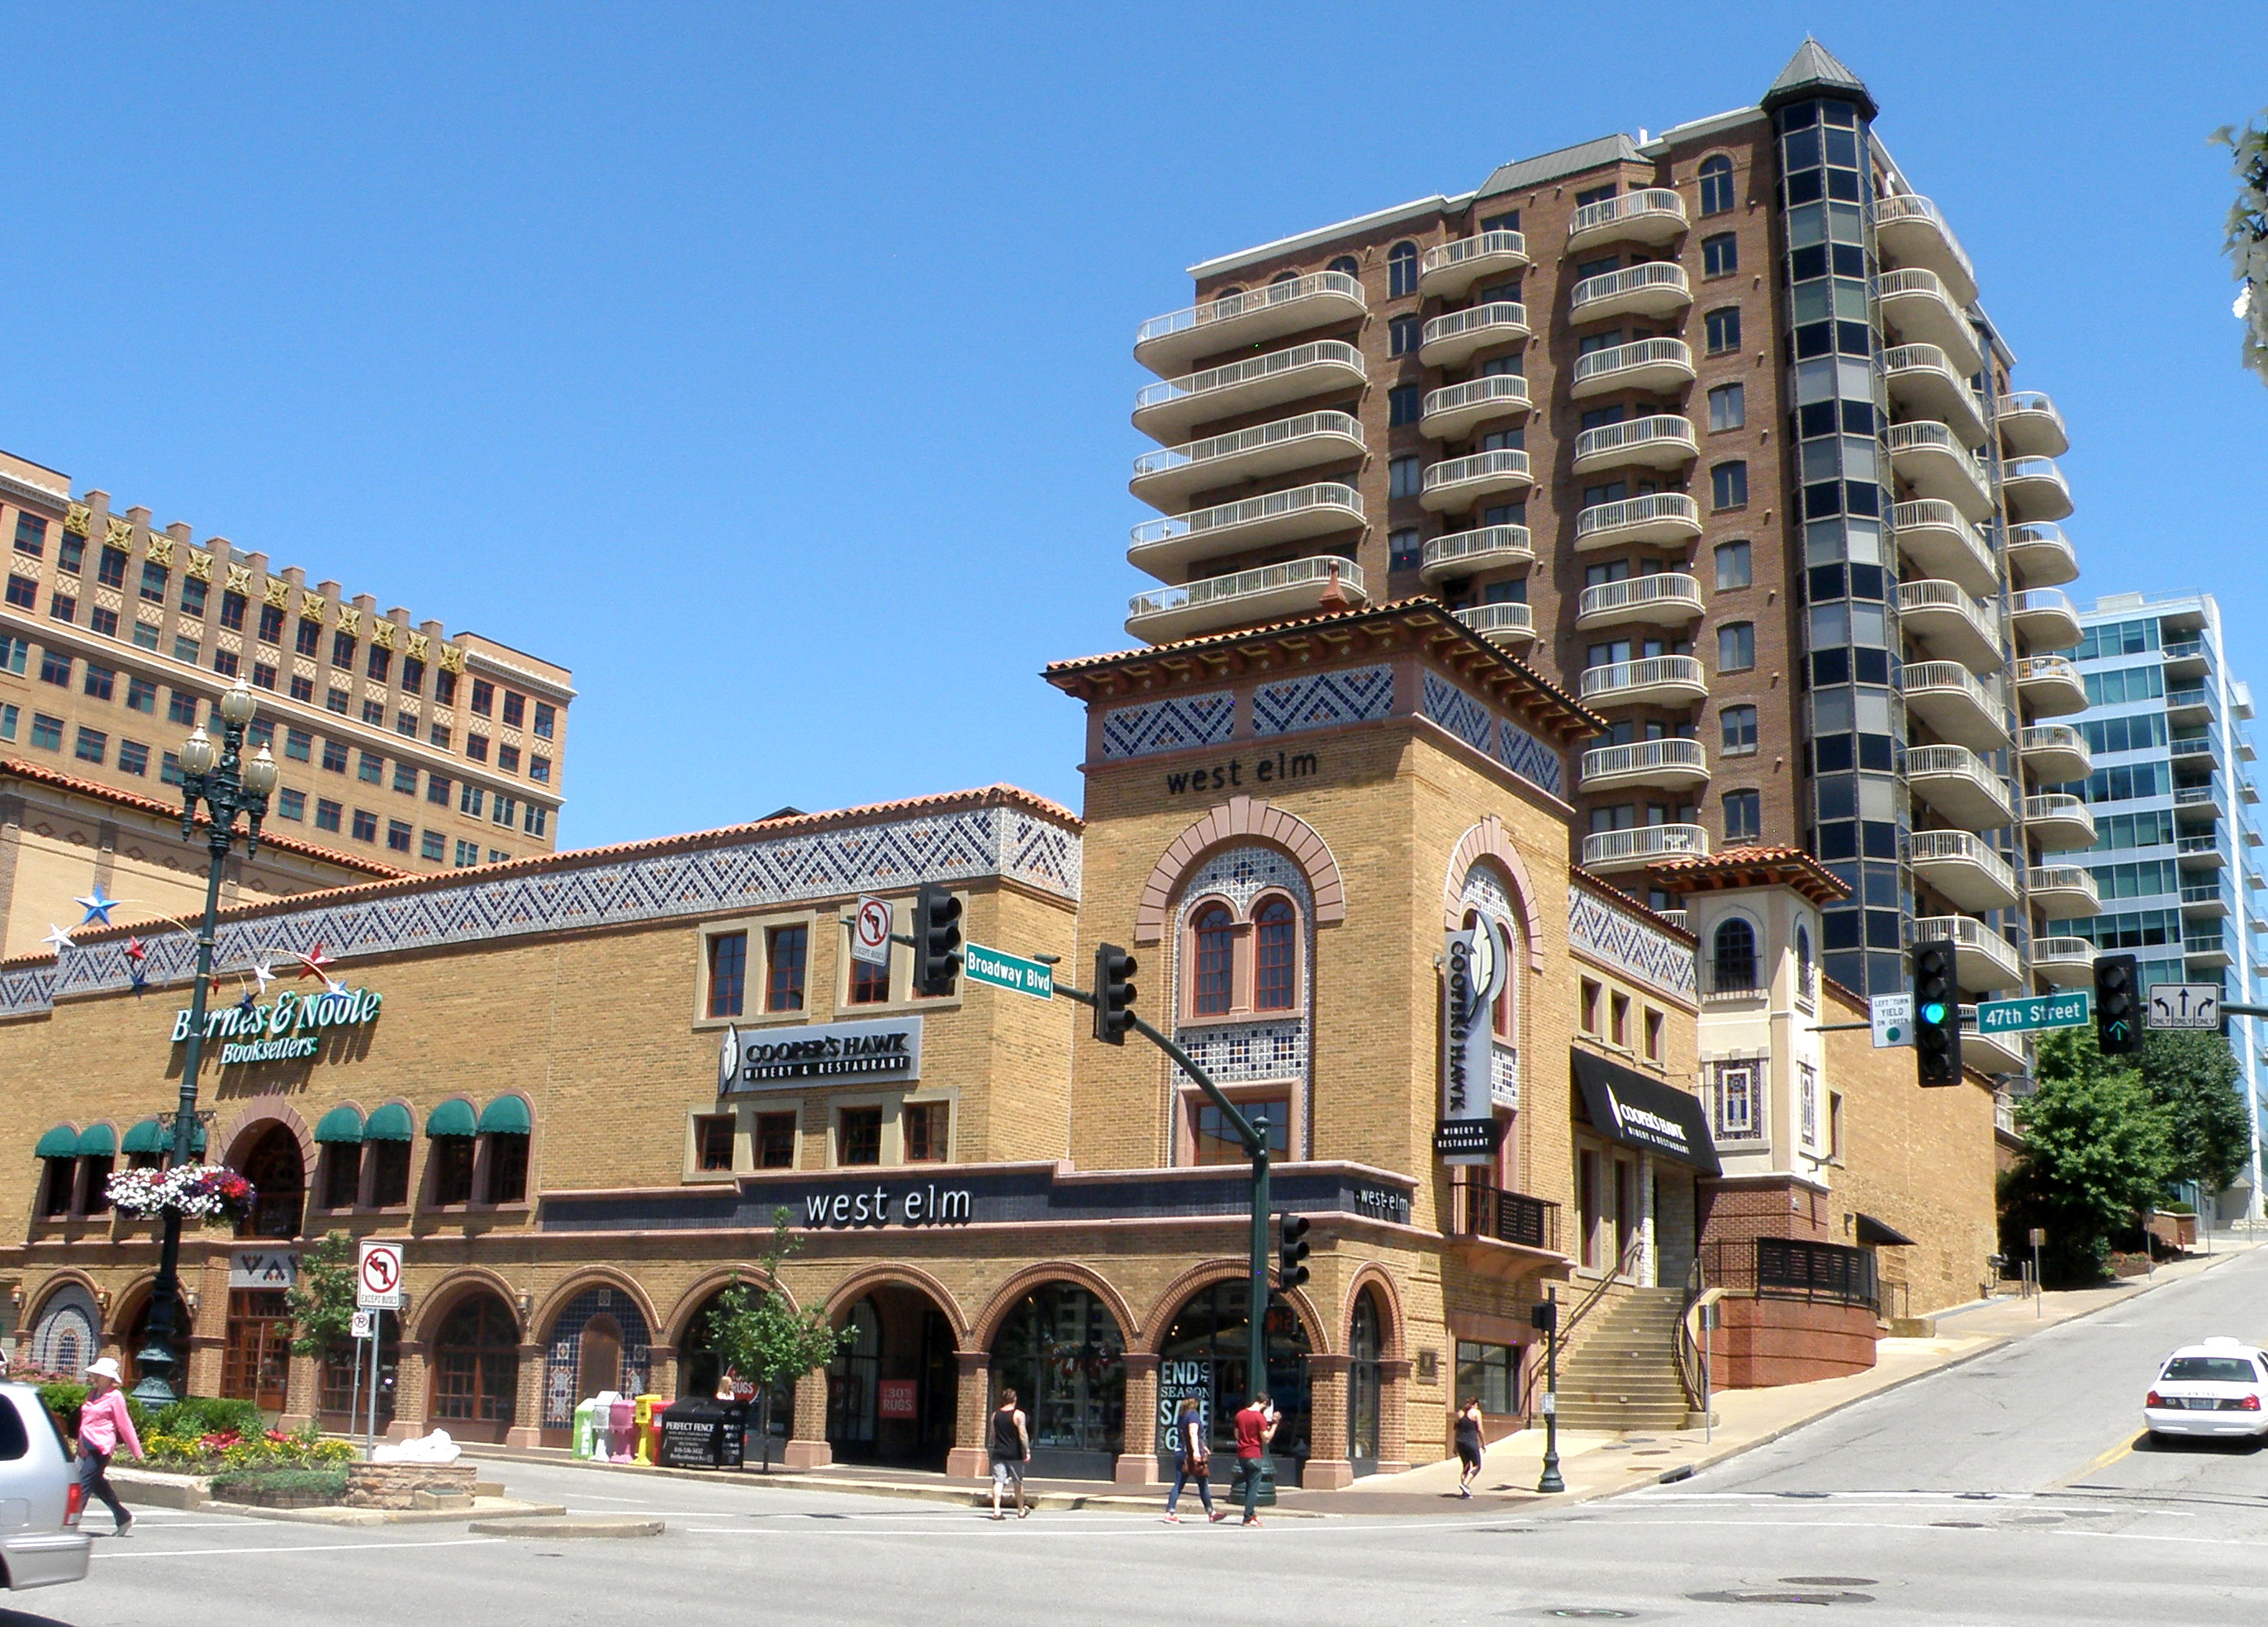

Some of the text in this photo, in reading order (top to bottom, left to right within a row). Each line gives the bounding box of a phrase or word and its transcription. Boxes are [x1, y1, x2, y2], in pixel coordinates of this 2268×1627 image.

[1167, 752, 1317, 795] west elm
[968, 951, 1050, 991] Broadway Blvd
[170, 1005, 270, 1041] Brnes
[269, 990, 300, 1034] &
[1881, 1008, 1903, 1017] YIELD
[1986, 1002, 2081, 1027] 47th Street
[221, 1037, 318, 1064] Booksellers
[746, 1032, 909, 1063] COOPER'S HAWK
[744, 1057, 906, 1080] WINERY & RESTAURANT
[1450, 1044, 1466, 1112] HAWK
[1438, 1137, 1488, 1148] RESTAURANT
[1443, 1126, 1474, 1136] WINERY
[807, 1184, 970, 1221] west elm
[1360, 1189, 1408, 1212] west elm
[1161, 1361, 1199, 1385] END
[731, 1381, 753, 1394] RUGS
[883, 1399, 913, 1411] RUGS
[1160, 1400, 1209, 1425] SE
[581, 1418, 591, 1455] ink
[666, 1421, 693, 1431] PERFECT
[694, 1423, 714, 1433] FENCE
